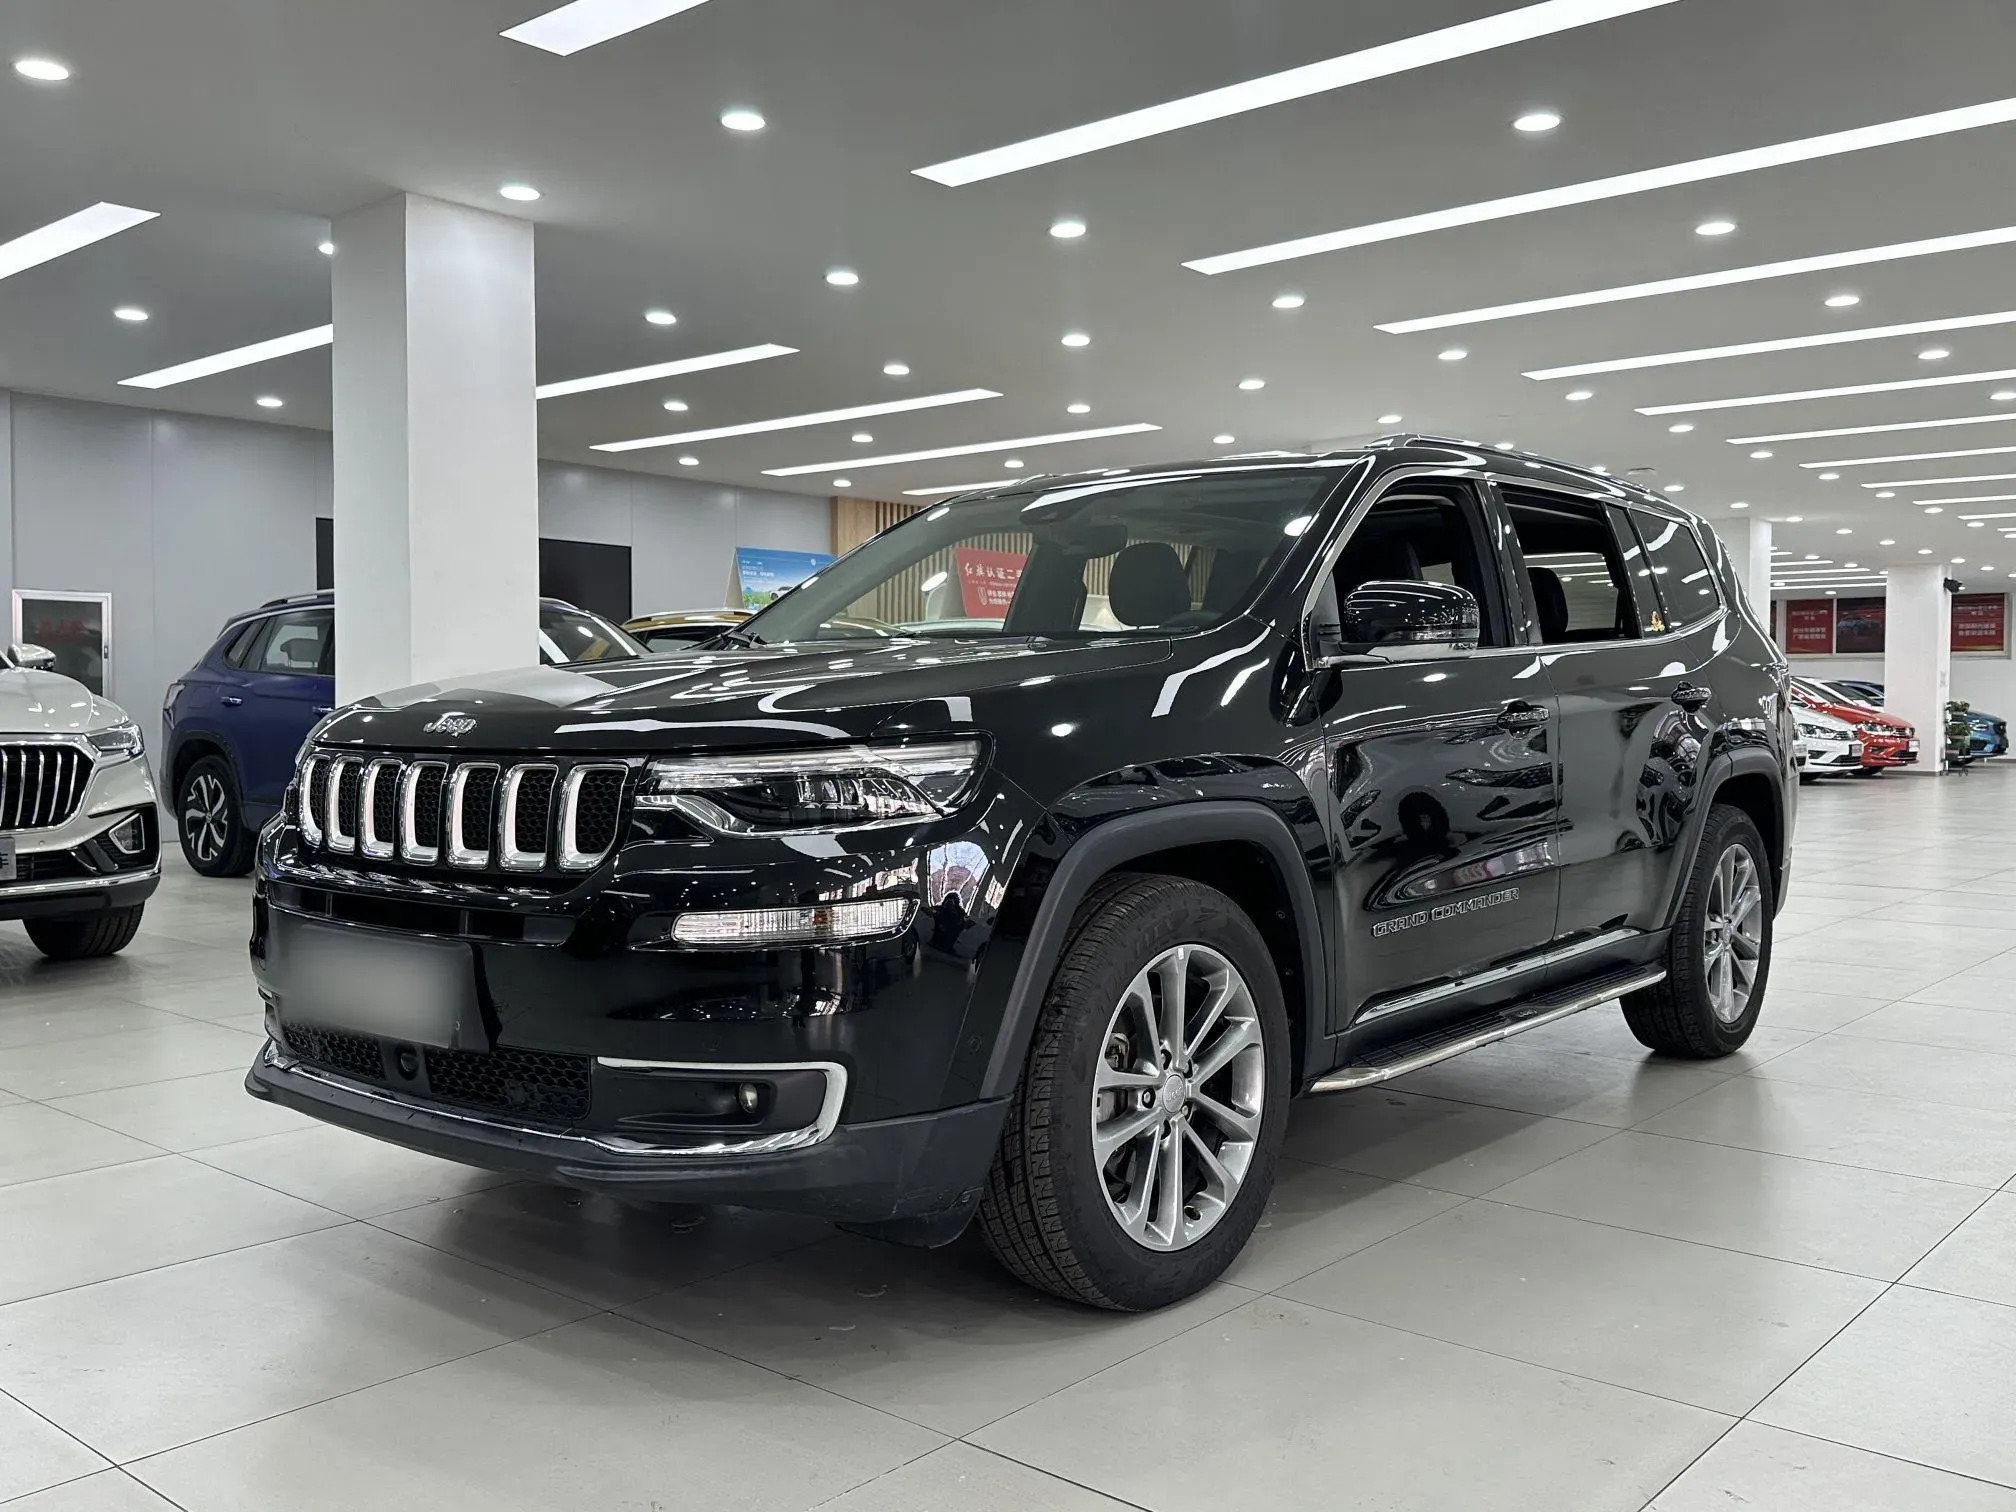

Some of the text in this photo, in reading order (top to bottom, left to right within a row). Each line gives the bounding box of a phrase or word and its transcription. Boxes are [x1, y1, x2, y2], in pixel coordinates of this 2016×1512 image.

[423, 711, 477, 738] Jeep
[1372, 887, 1520, 937] GRAND COMMANDER
